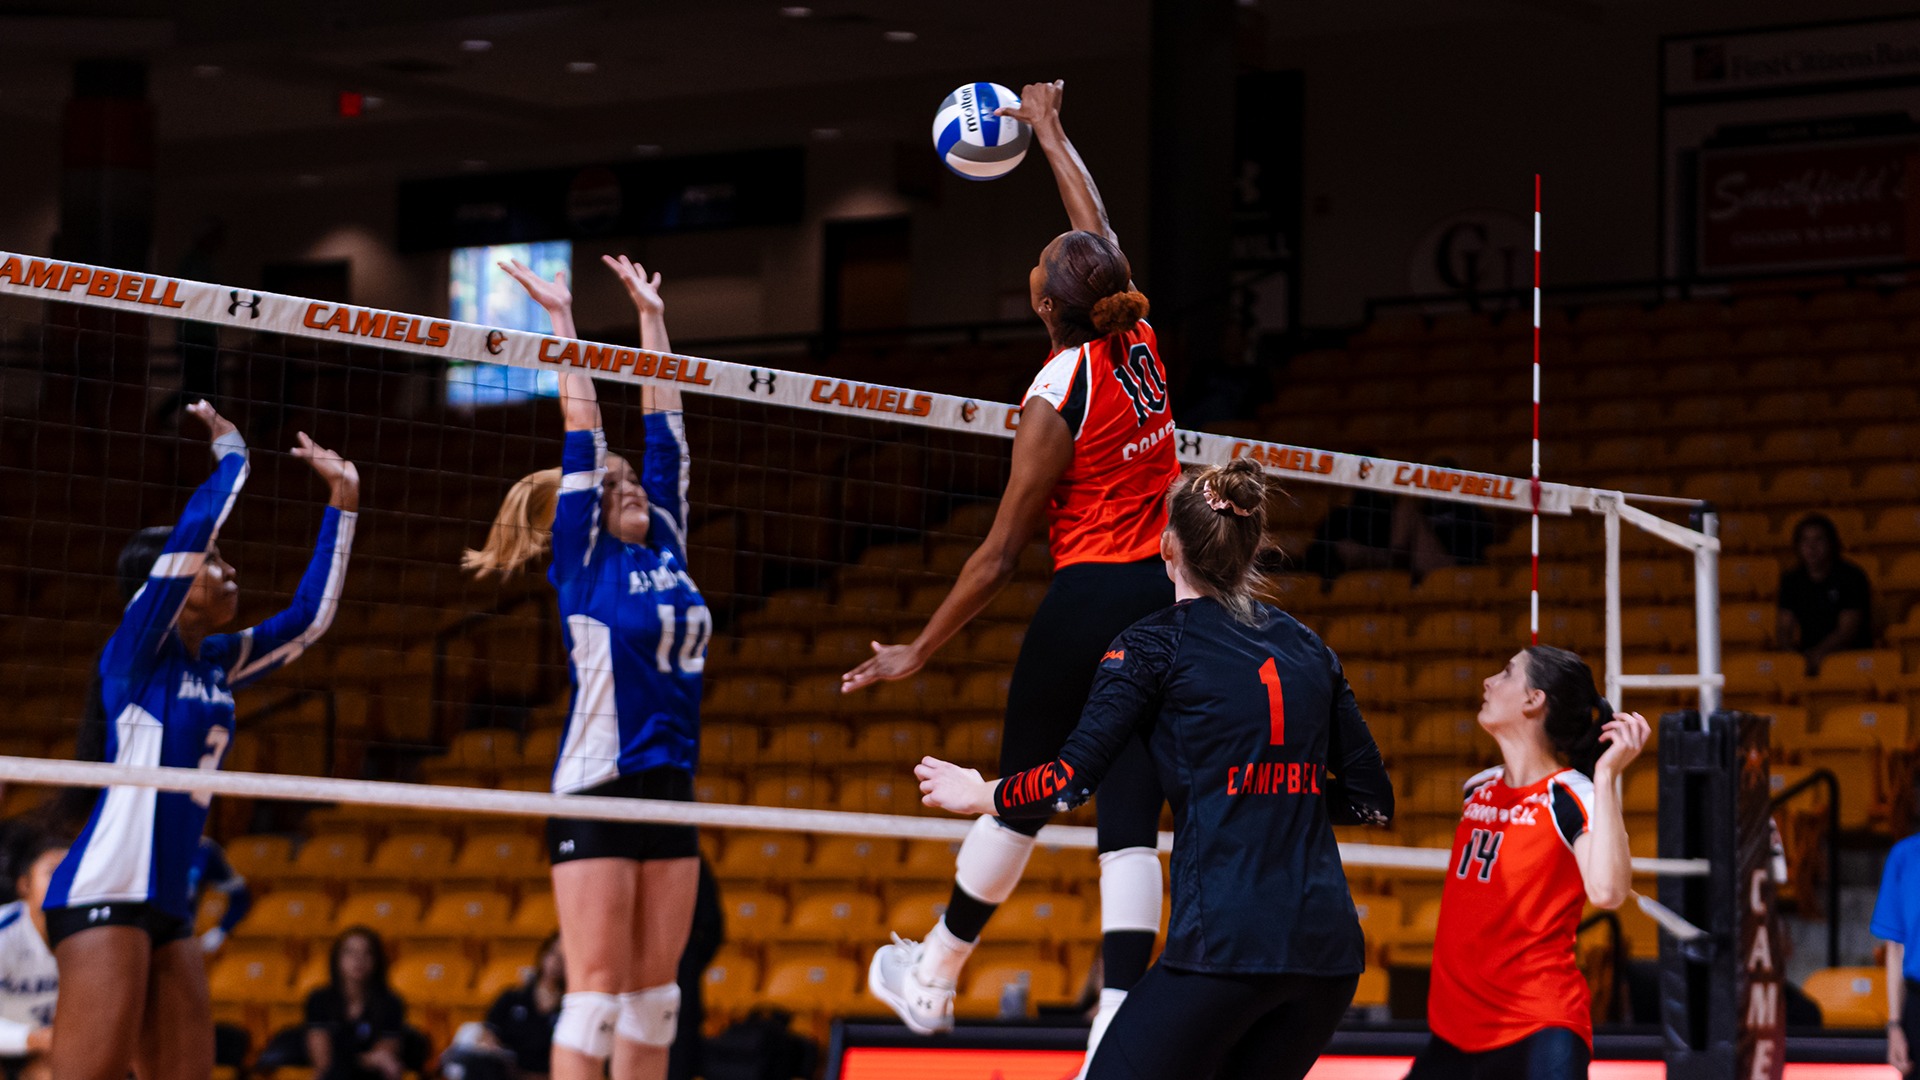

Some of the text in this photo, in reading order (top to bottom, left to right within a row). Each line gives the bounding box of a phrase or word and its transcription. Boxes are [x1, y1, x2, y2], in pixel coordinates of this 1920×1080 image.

[960, 86, 979, 133] molten
[303, 303, 452, 348] CAMELS
[538, 337, 713, 387] CAMPBELL
[810, 378, 933, 418] CAMELS
[1231, 441, 1334, 475] CAMELS
[1393, 464, 1517, 500] CAMPBELL
[1113, 342, 1168, 428] 10
[655, 603, 713, 674] 10
[1258, 656, 1285, 746] 1
[1227, 762, 1325, 795] CAMPBEL
[1456, 828, 1504, 883] 14
